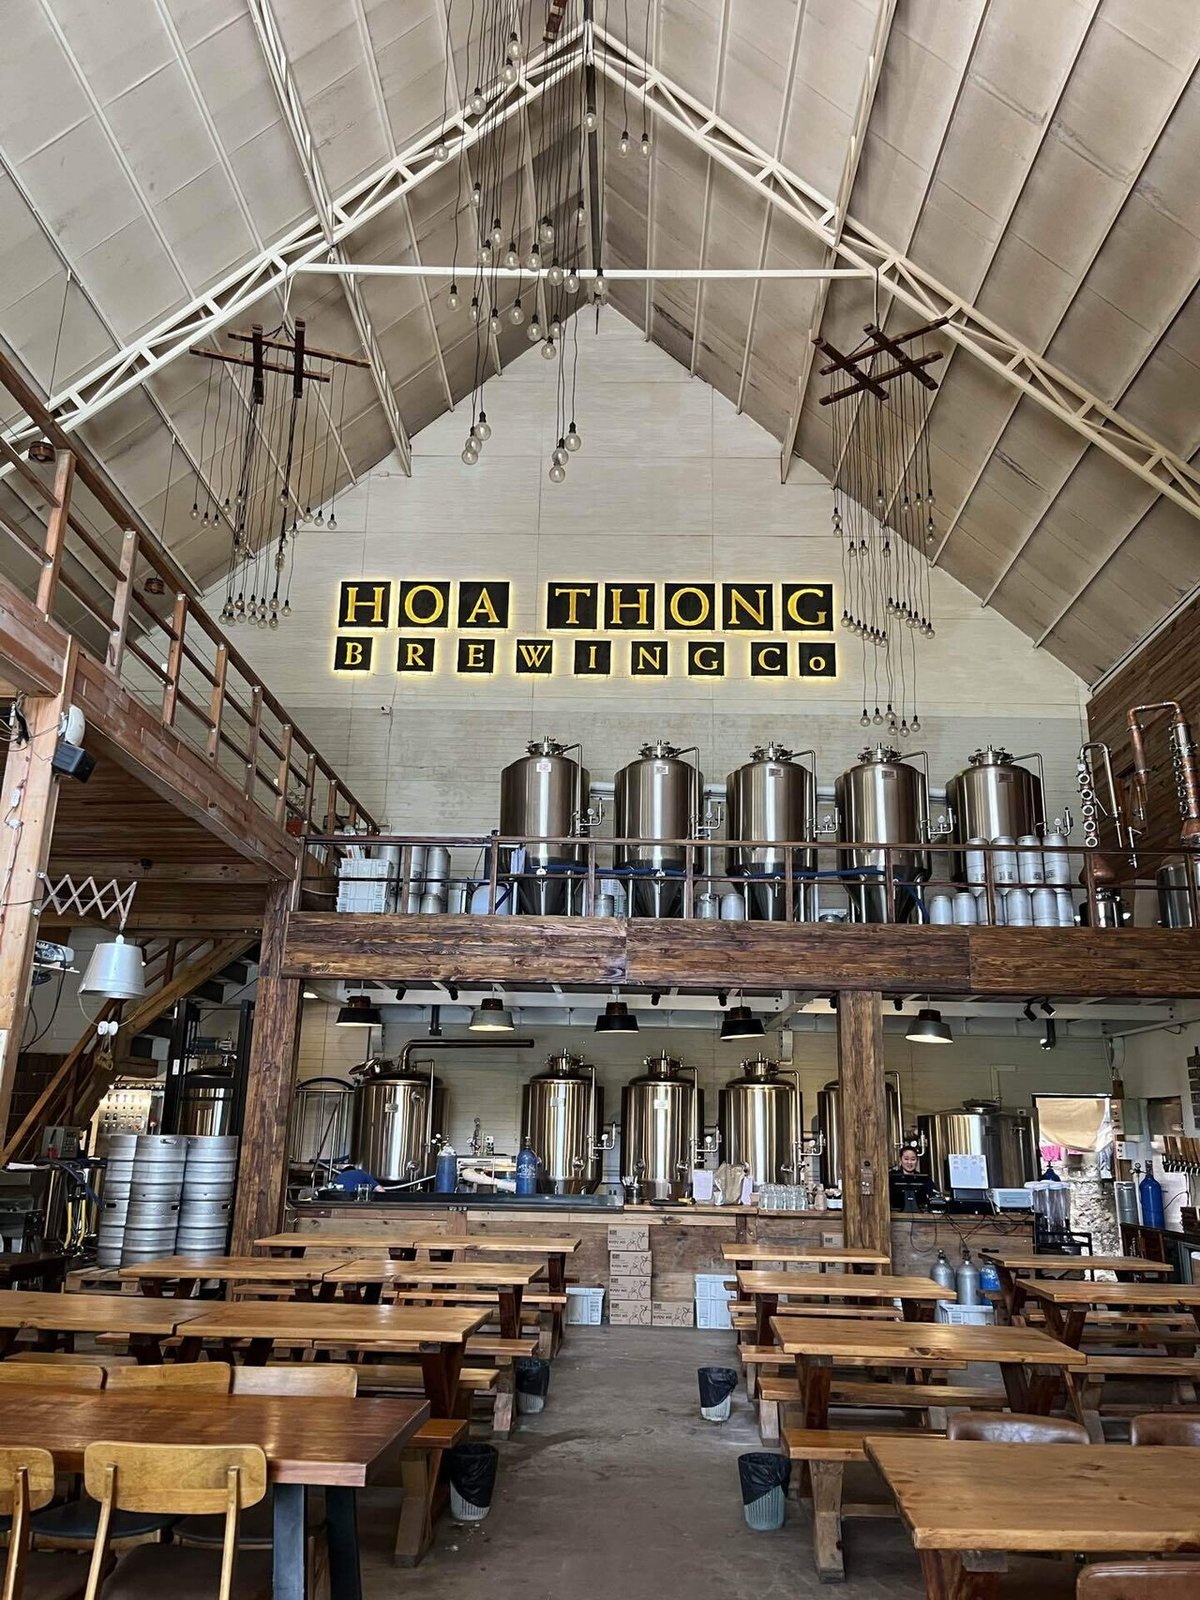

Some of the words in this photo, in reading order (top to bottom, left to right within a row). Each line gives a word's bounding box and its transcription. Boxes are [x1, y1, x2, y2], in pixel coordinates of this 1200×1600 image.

[346, 585, 500, 624] HOA
[555, 587, 827, 626] THONG
[344, 642, 720, 669] BREWING
[757, 647, 826, 672] Co
